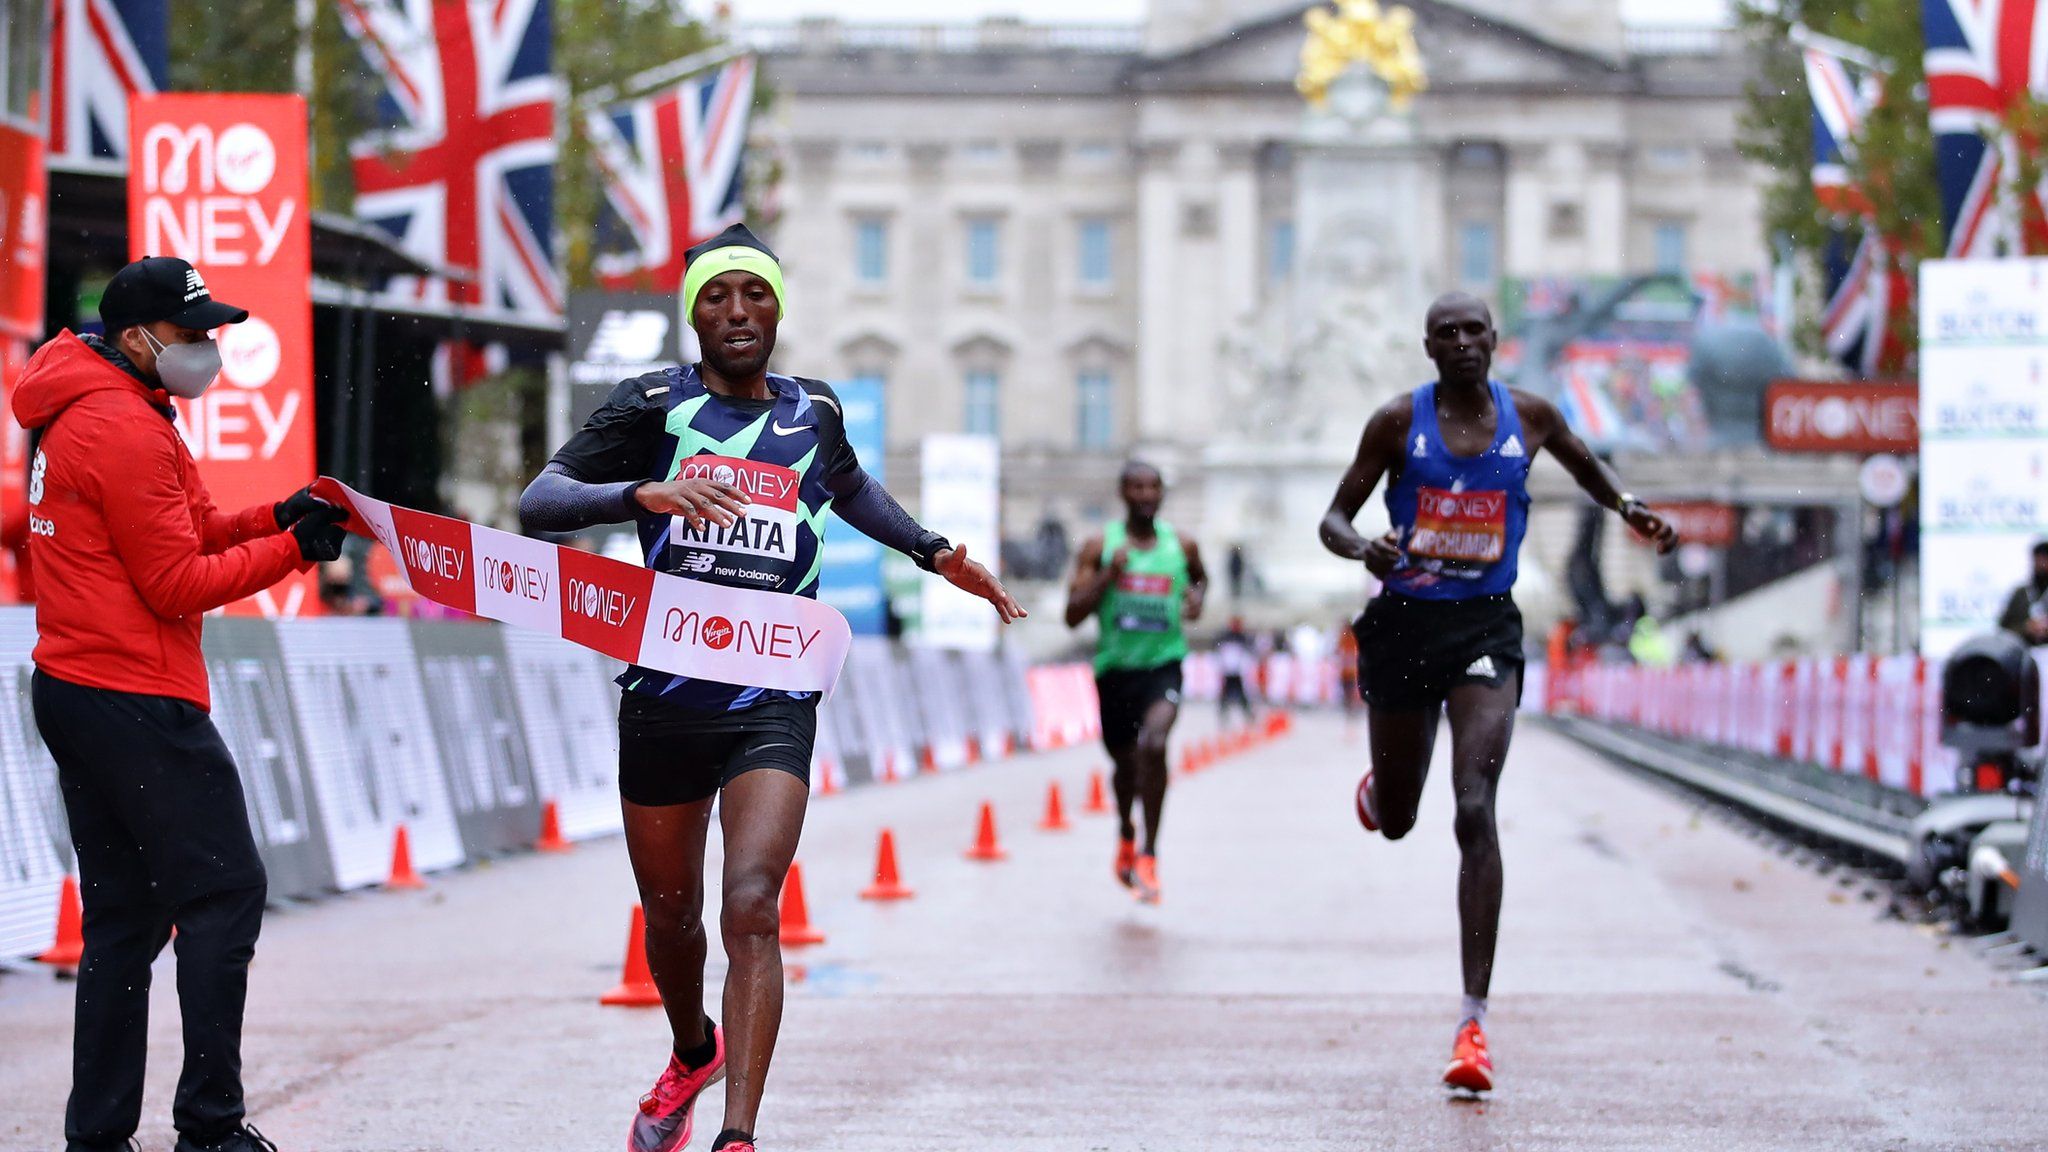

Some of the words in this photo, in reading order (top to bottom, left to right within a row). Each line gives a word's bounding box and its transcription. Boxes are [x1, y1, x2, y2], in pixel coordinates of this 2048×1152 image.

[145, 196, 297, 267] NEY
[1421, 492, 1501, 518] MONEY
[404, 535, 464, 581] MONEY
[484, 556, 548, 602] MONEY
[715, 566, 737, 577] new
[739, 567, 781, 583] balance
[569, 578, 636, 627] MONEY
[663, 607, 822, 659] MONEY
[704, 620, 732, 645] Virgin
